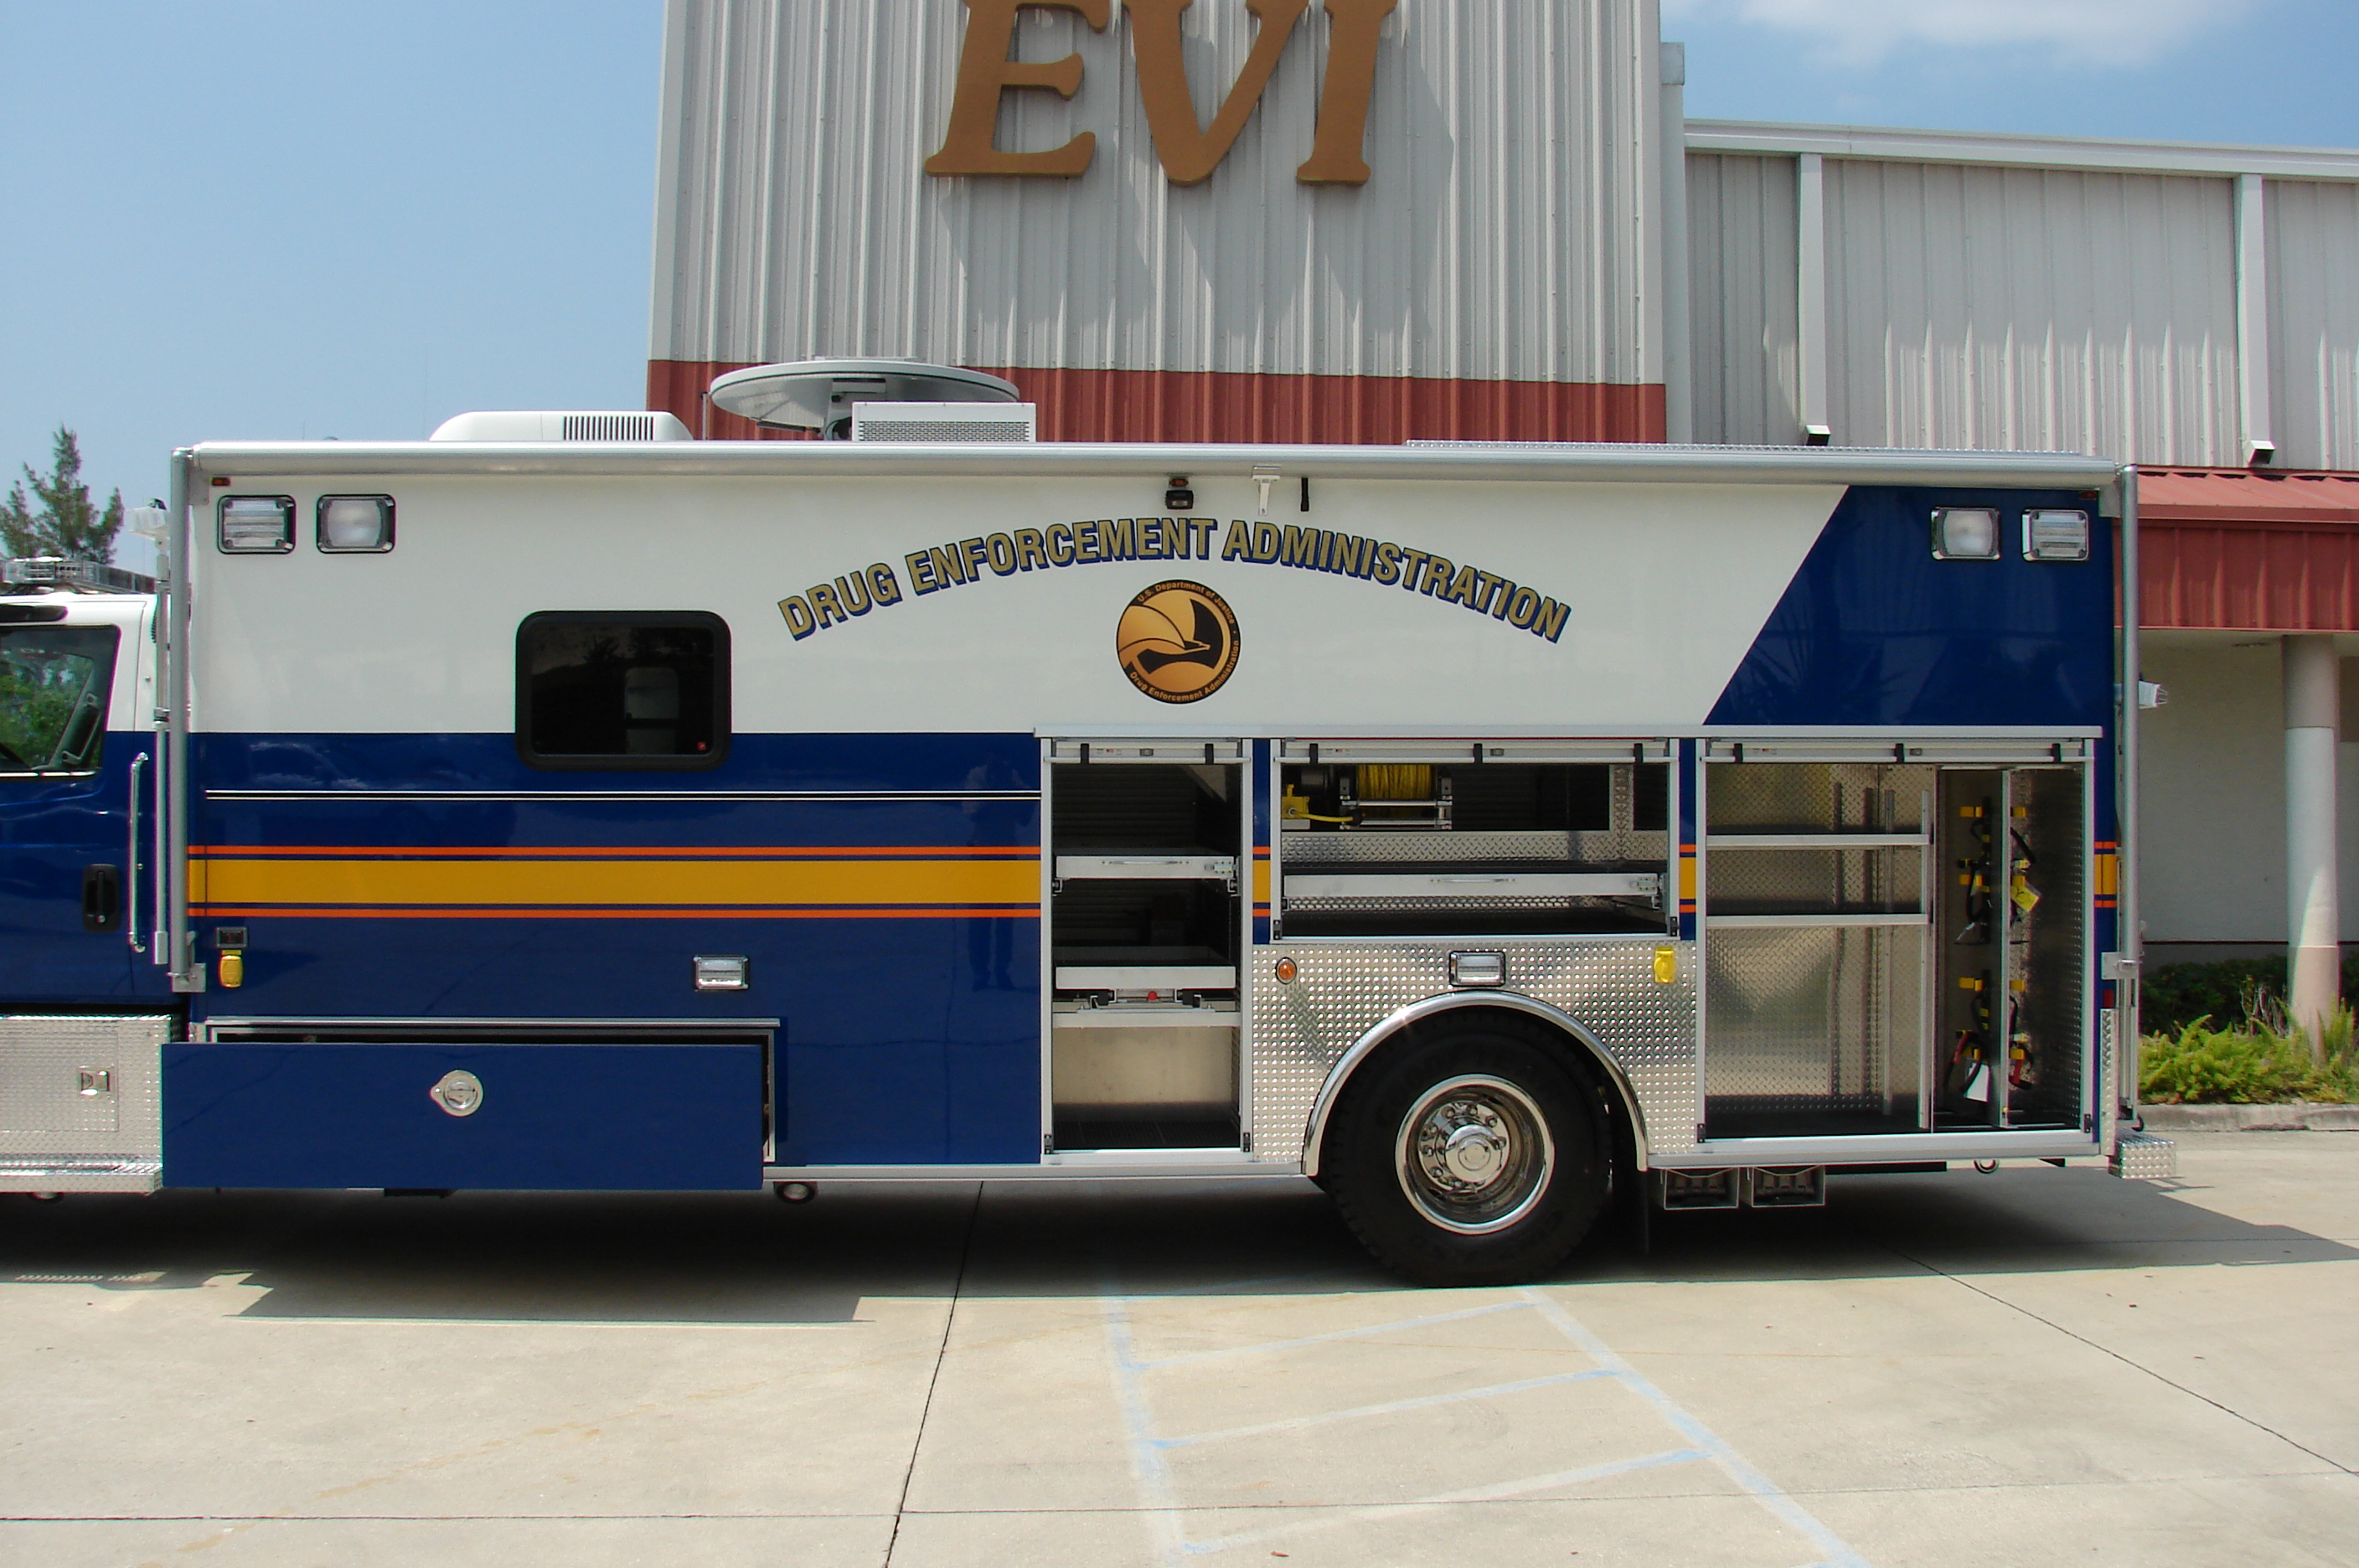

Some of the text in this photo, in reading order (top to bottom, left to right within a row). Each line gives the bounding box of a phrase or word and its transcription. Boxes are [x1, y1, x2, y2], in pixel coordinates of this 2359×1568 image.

[925, 0, 1396, 185] EVI
[777, 518, 1571, 644] DRUG ENFORCEMENT ADMINISTRATION
[1137, 582, 1234, 624] U.S. Department of Justice
[1130, 640, 1240, 702] Drug Enforcement Administration
